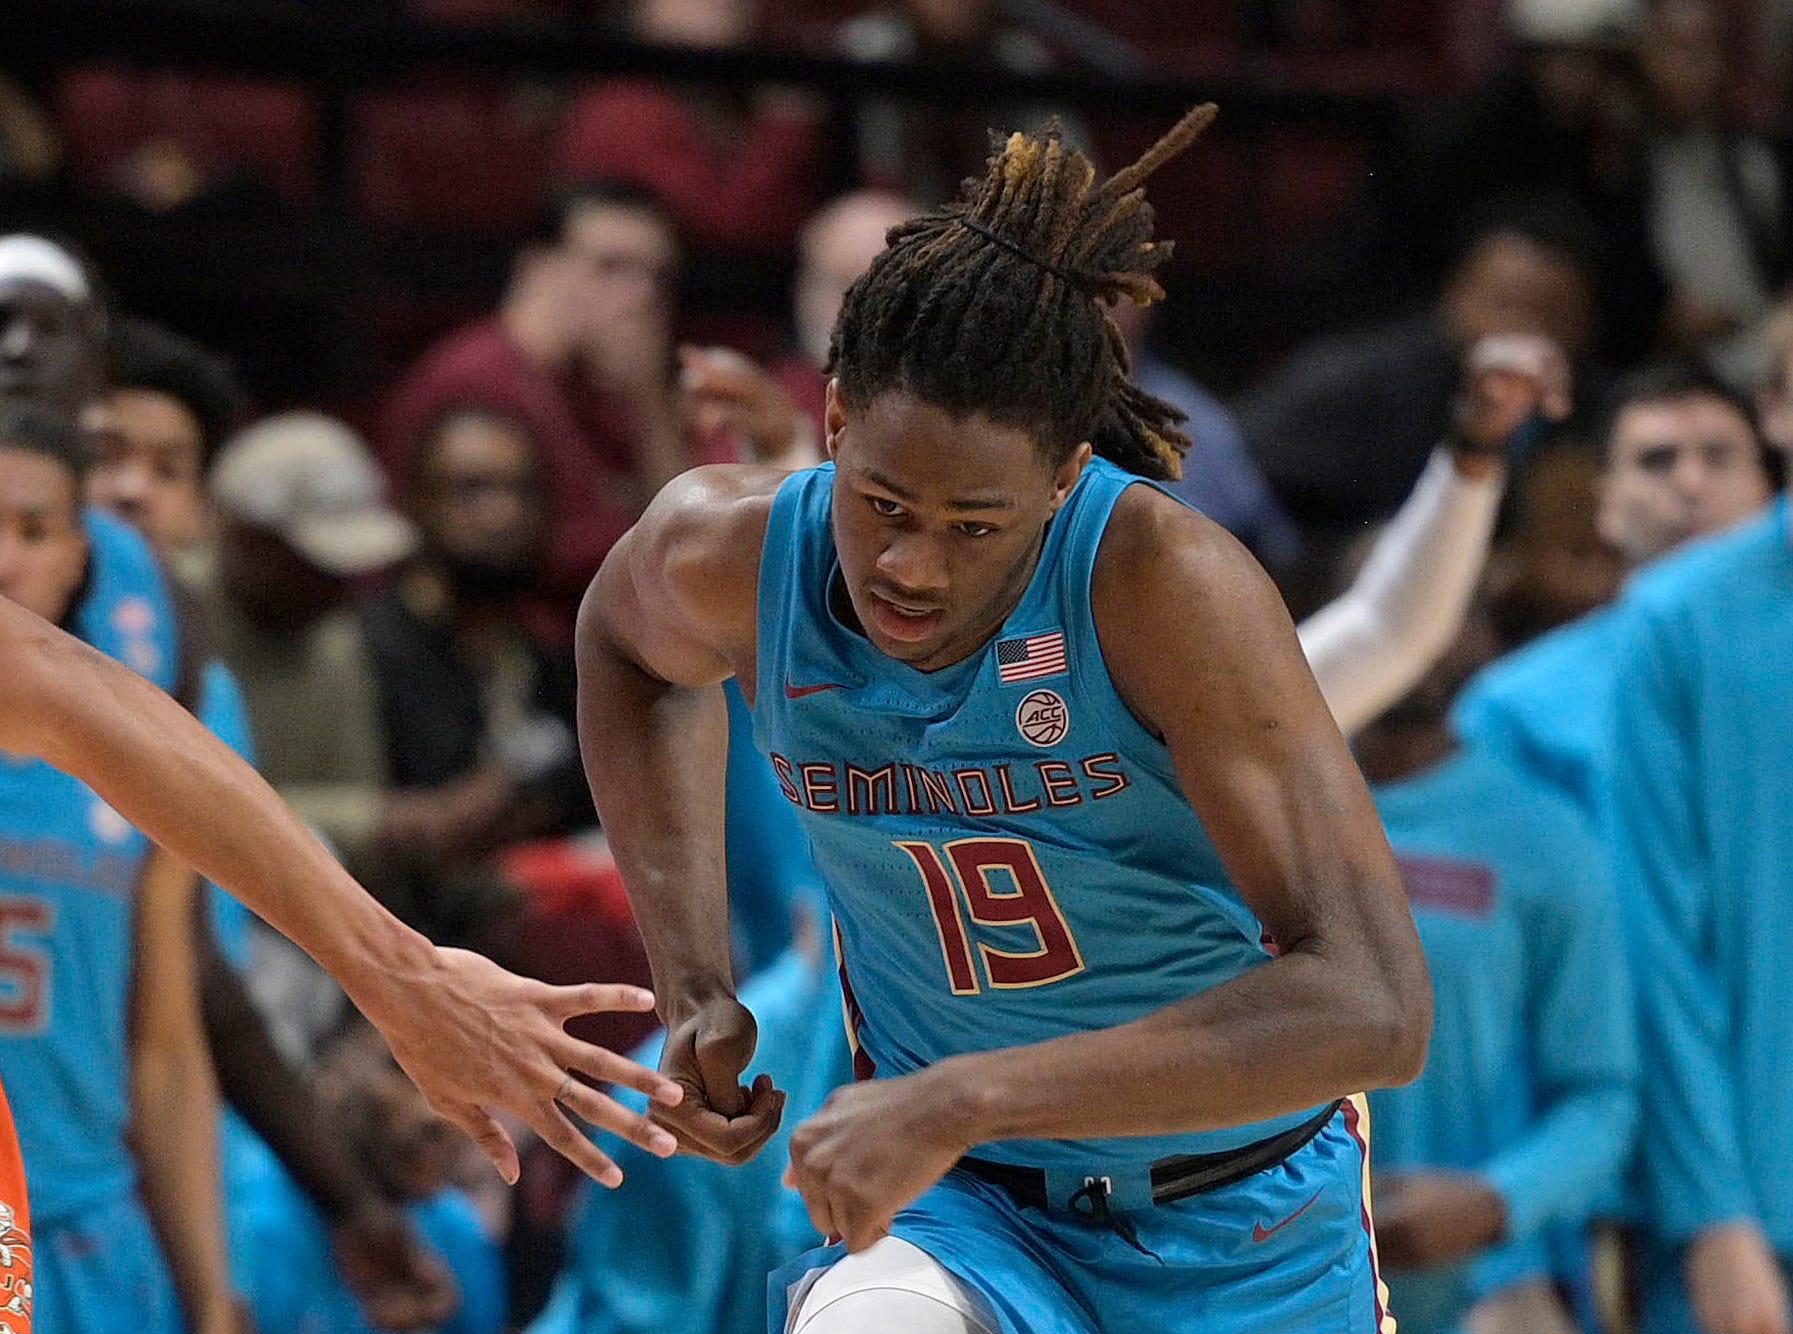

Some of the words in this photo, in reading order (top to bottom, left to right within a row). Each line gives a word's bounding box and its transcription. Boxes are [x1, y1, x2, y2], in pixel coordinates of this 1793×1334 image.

[1025, 705, 1062, 724] ACC
[770, 751, 1132, 816] SEMINOLES
[891, 837, 1086, 995] 19
